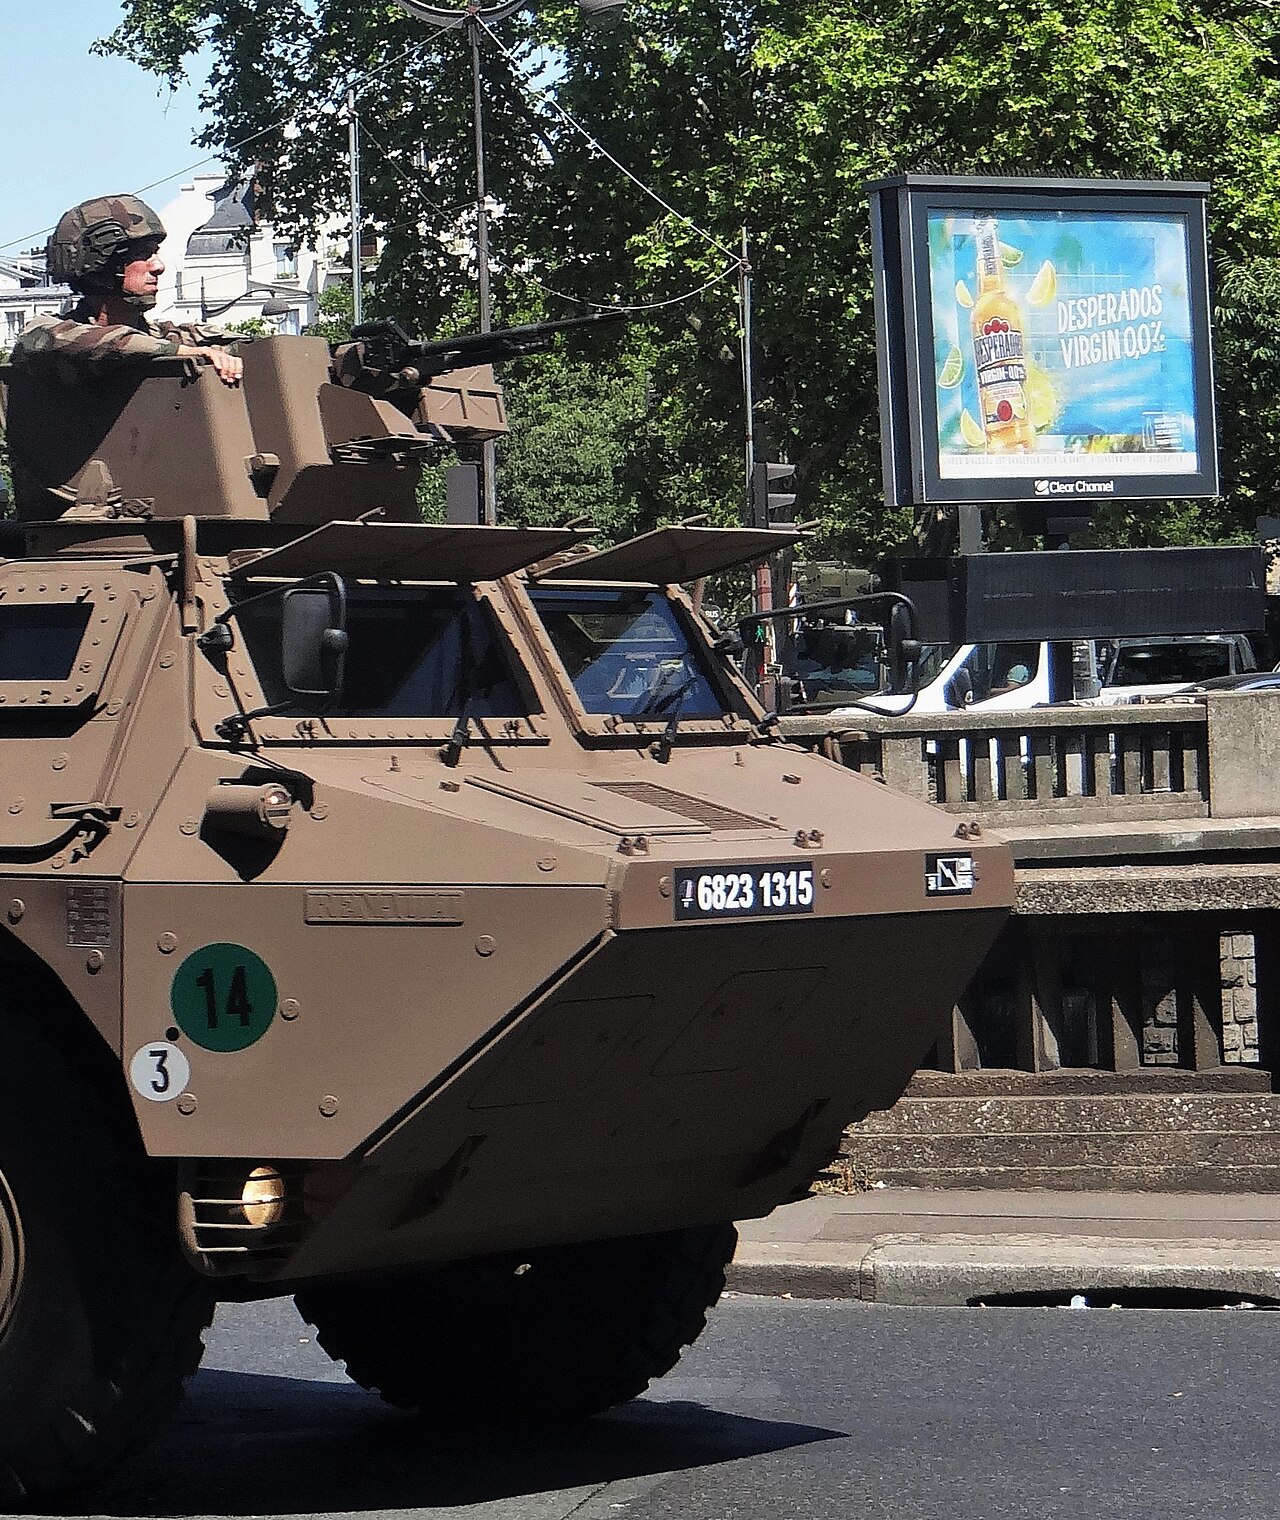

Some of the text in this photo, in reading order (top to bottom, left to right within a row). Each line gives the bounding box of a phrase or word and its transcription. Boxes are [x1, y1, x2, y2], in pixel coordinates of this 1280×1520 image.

[1057, 284, 1163, 334] DESPERADOS
[1060, 320, 1166, 369] VIRGIN 0,0%
[1049, 479, 1114, 493] Clear Channel
[697, 870, 813, 911] 6823 1315
[195, 964, 253, 1029] 14
[148, 1049, 169, 1093] 3
